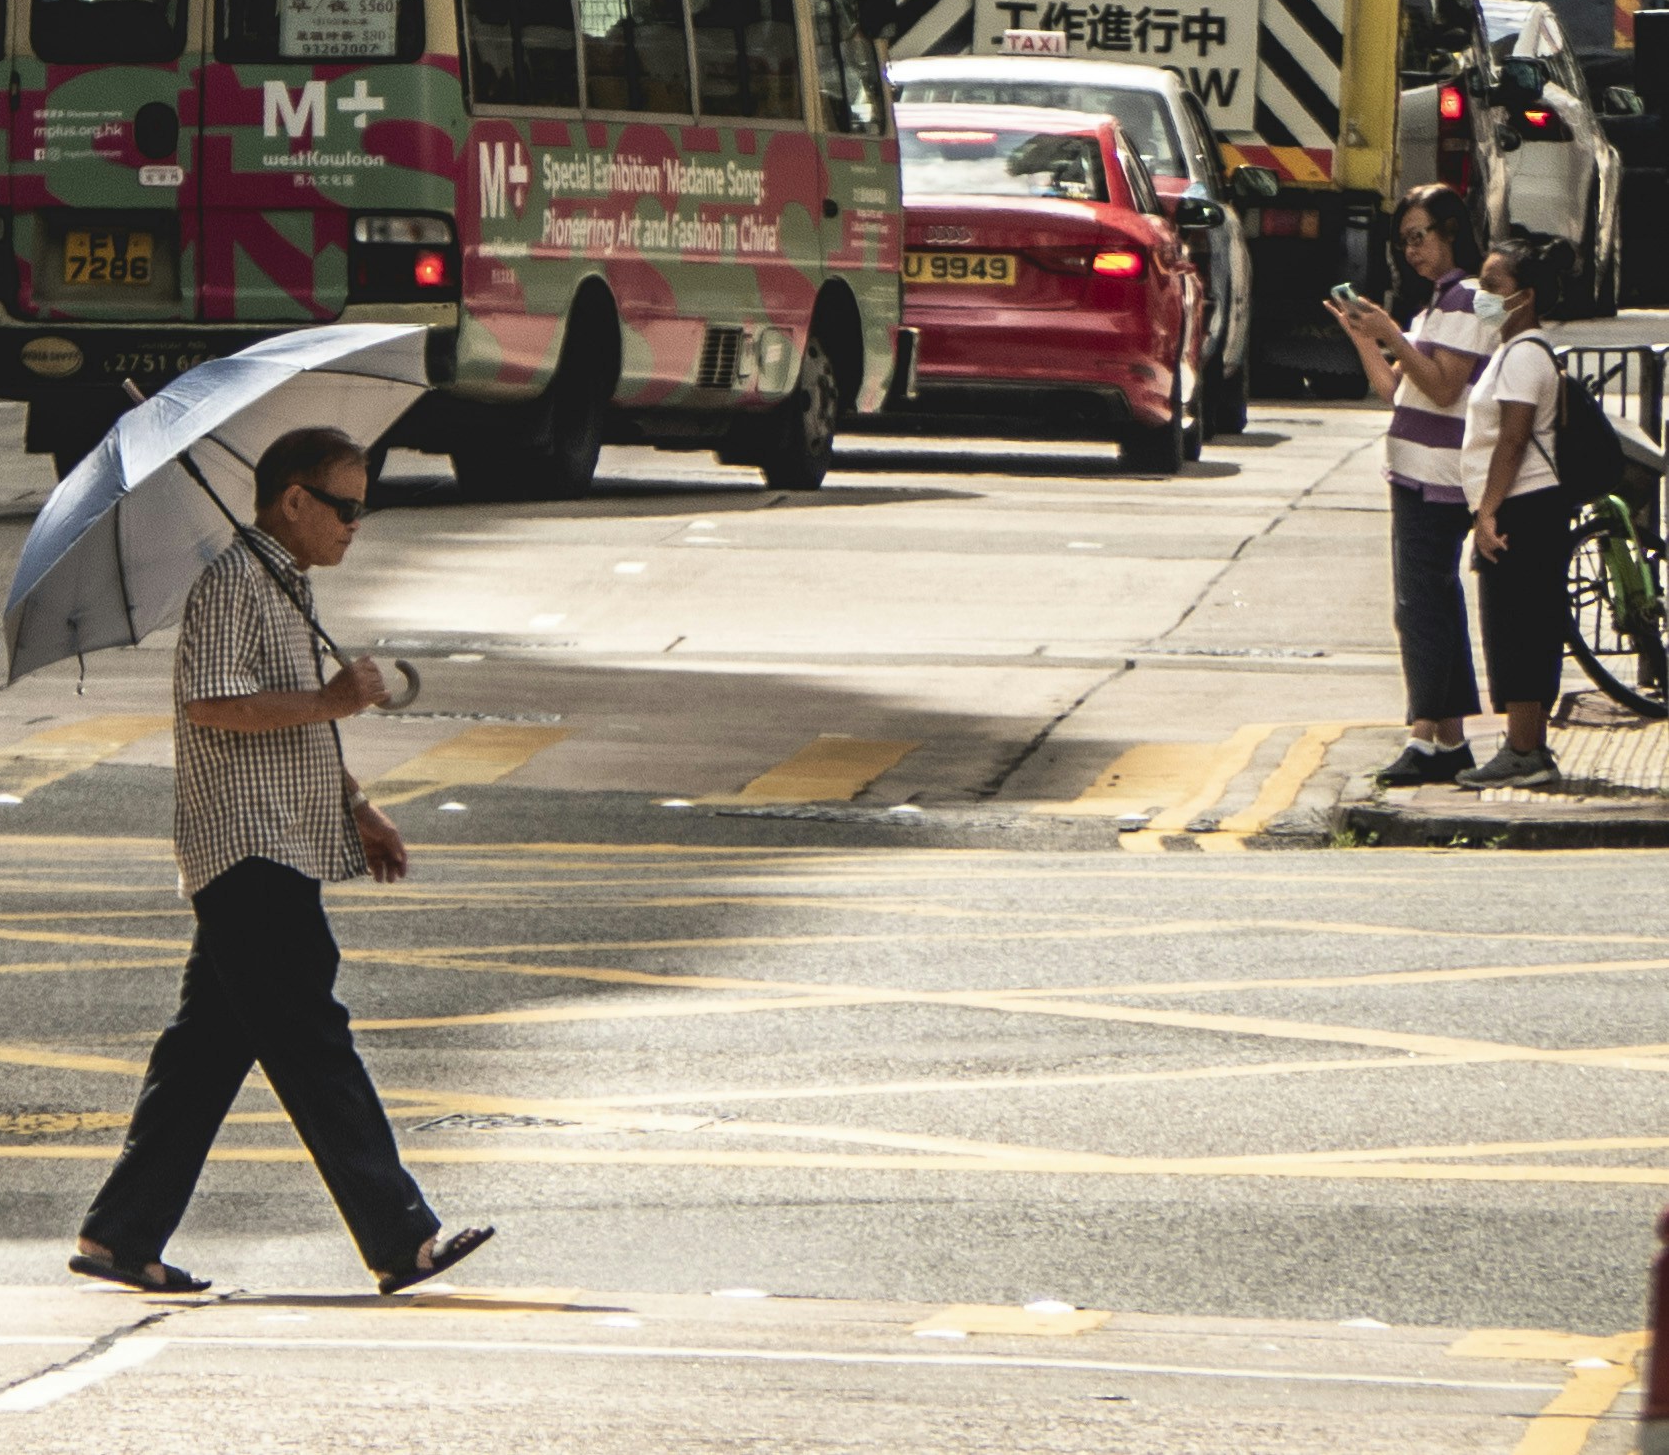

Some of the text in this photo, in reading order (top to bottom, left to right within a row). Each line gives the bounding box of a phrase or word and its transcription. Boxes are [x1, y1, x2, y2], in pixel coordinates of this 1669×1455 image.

[990, 1, 1227, 57] 工作進行中
[1007, 34, 1061, 53] TAXI
[262, 79, 385, 138] M+
[33, 123, 123, 140] mplus.org.hk
[479, 141, 529, 219] M+
[542, 152, 590, 198] Special
[592, 154, 661, 194] Exhibition
[89, 231, 131, 260] FV
[542, 208, 615, 255] Pioneering
[617, 210, 641, 247] Art
[643, 212, 669, 248] and
[671, 212, 722, 250] Fashion
[724, 213, 737, 251] in
[68, 256, 149, 281] 7286
[930, 256, 1008, 280] 9949
[114, 353, 167, 372] 2751
